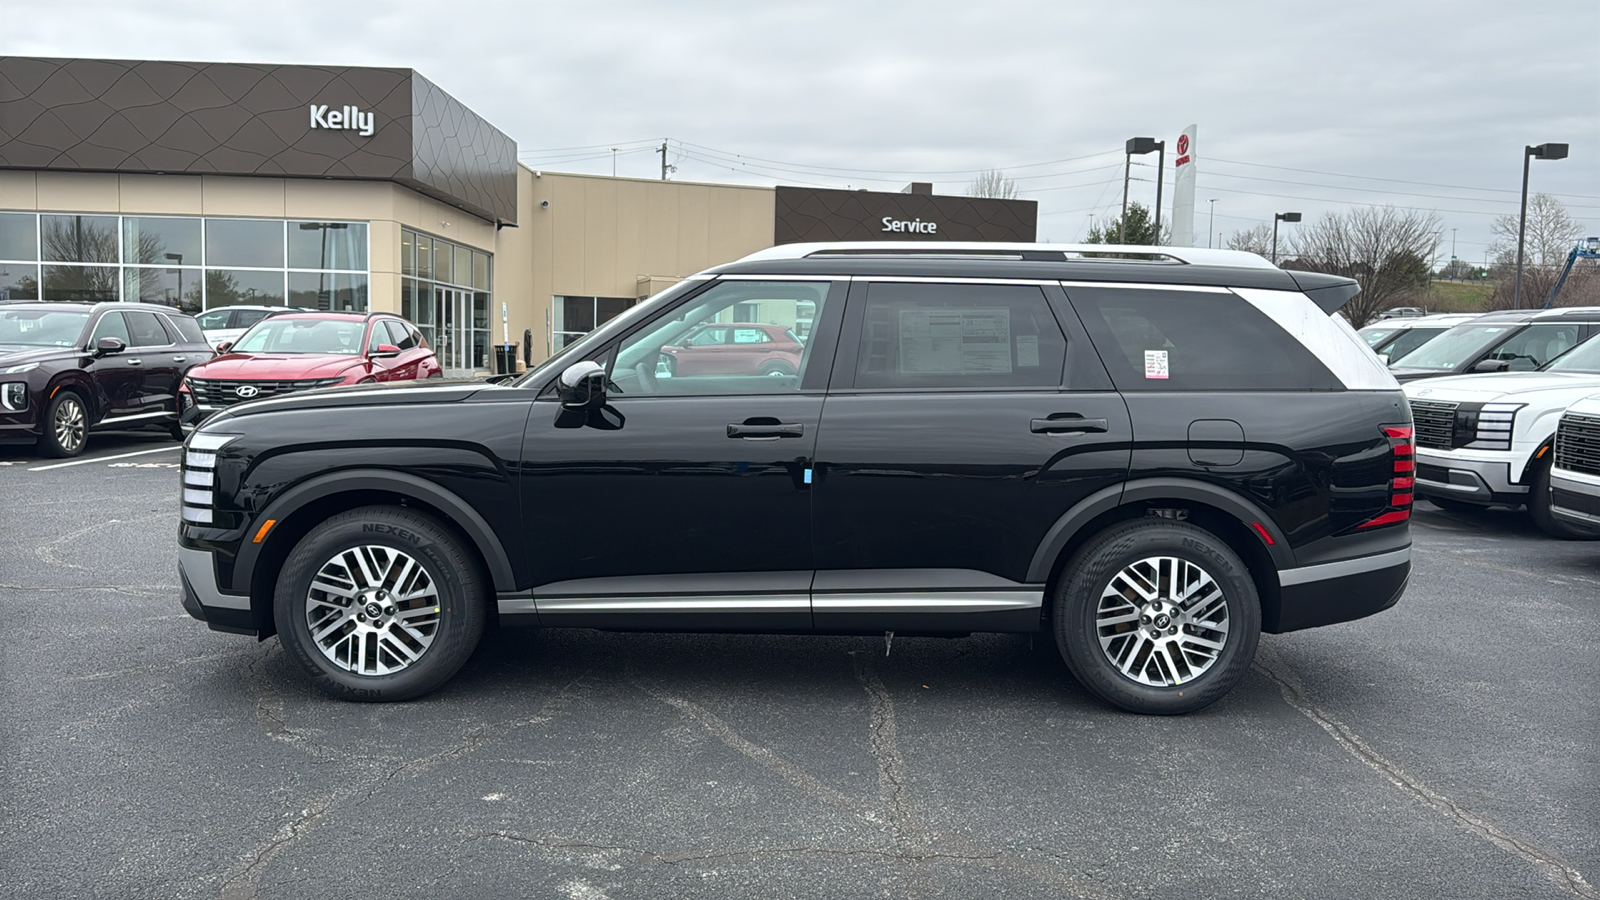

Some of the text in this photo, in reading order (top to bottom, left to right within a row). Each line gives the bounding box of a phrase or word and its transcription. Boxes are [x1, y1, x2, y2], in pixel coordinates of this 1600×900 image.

[310, 104, 374, 136] Kelly
[881, 216, 937, 234] Service
[362, 523, 420, 545] NEXEN
[1182, 537, 1234, 573] NEXEN
